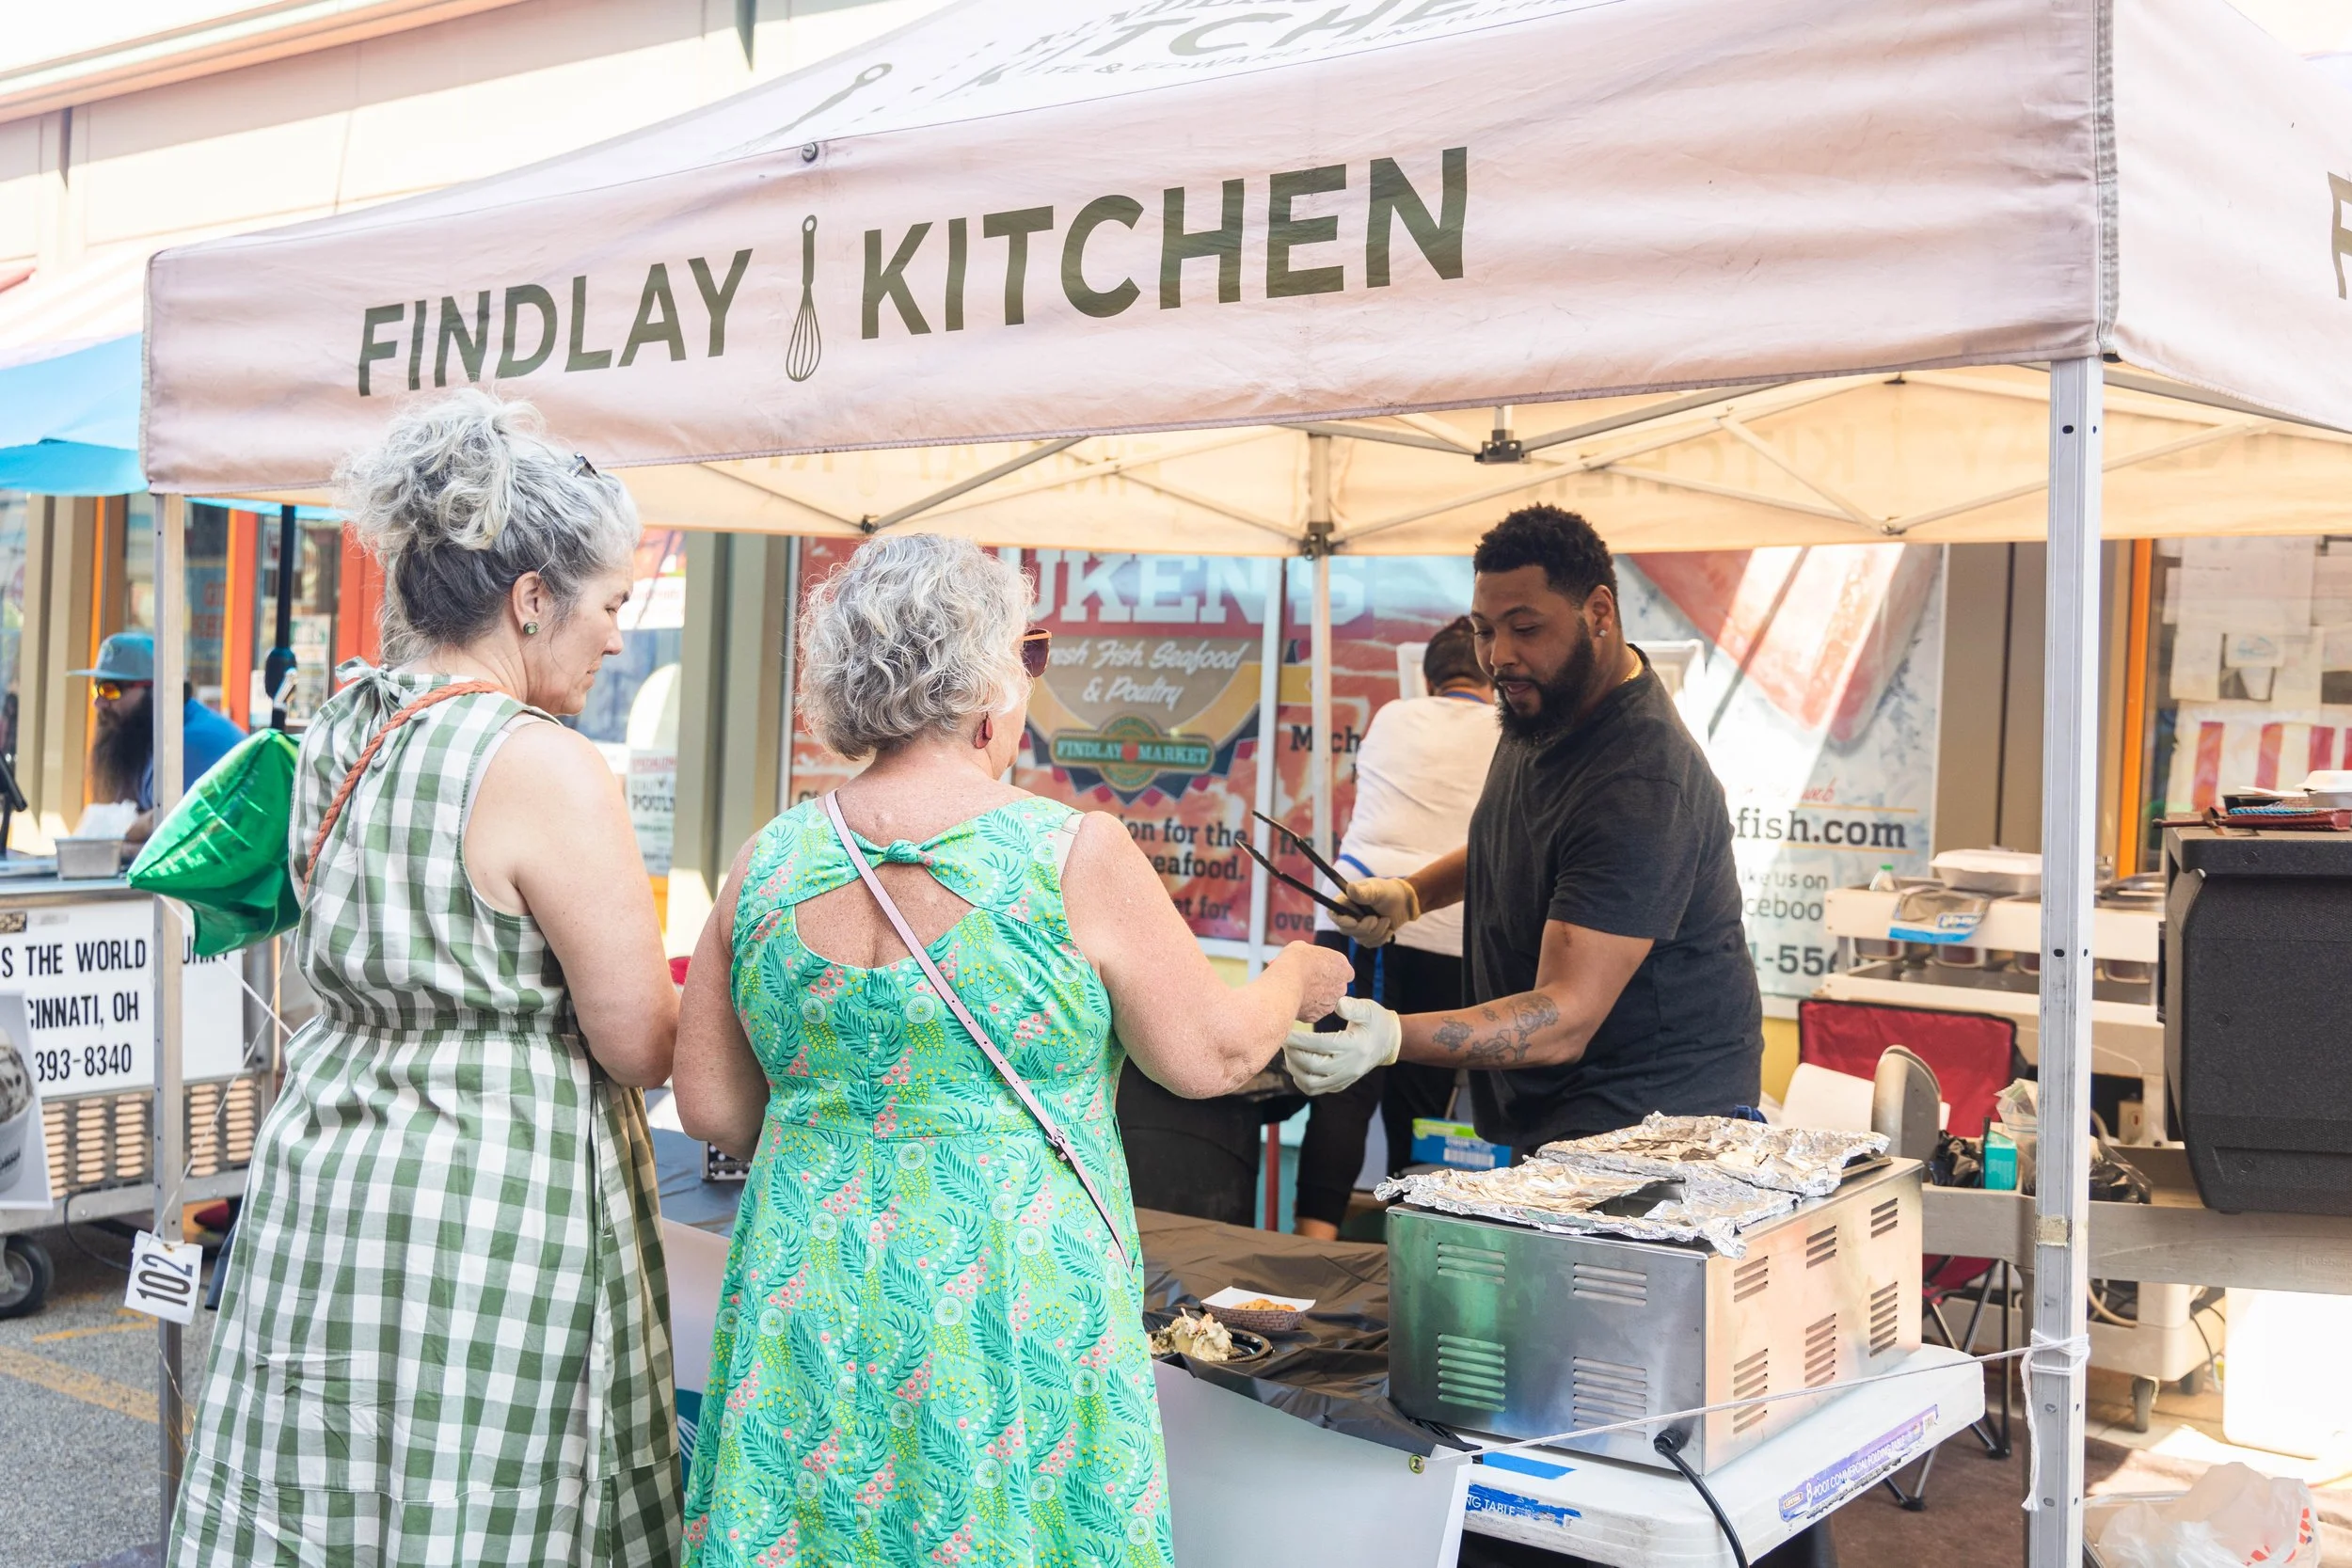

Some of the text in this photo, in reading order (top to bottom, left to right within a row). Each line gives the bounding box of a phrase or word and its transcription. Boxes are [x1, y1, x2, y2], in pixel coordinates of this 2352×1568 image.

[358, 147, 1469, 397] FINDLAY KITCHEN
[1049, 640, 1089, 666] resh
[1149, 640, 1250, 675] Seafood
[1082, 674, 1184, 711] & Poultry
[1057, 740, 1209, 765] FINDLAY MARKET
[1290, 724, 1360, 754] Mch
[1163, 816, 1200, 844] for
[1206, 820, 1248, 848] the
[1736, 806, 1907, 848] fish.com
[1146, 850, 1247, 880] eafood.
[1803, 871, 1829, 891] on
[1199, 894, 1232, 920] for
[1275, 911, 1315, 934] ove
[1744, 894, 1823, 922] ceboo
[25, 942, 64, 976] THE
[76, 939, 147, 974] WORLD
[113, 990, 139, 1022] OH
[135, 1253, 194, 1307] 102
[1466, 1496, 1482, 1509] NG
